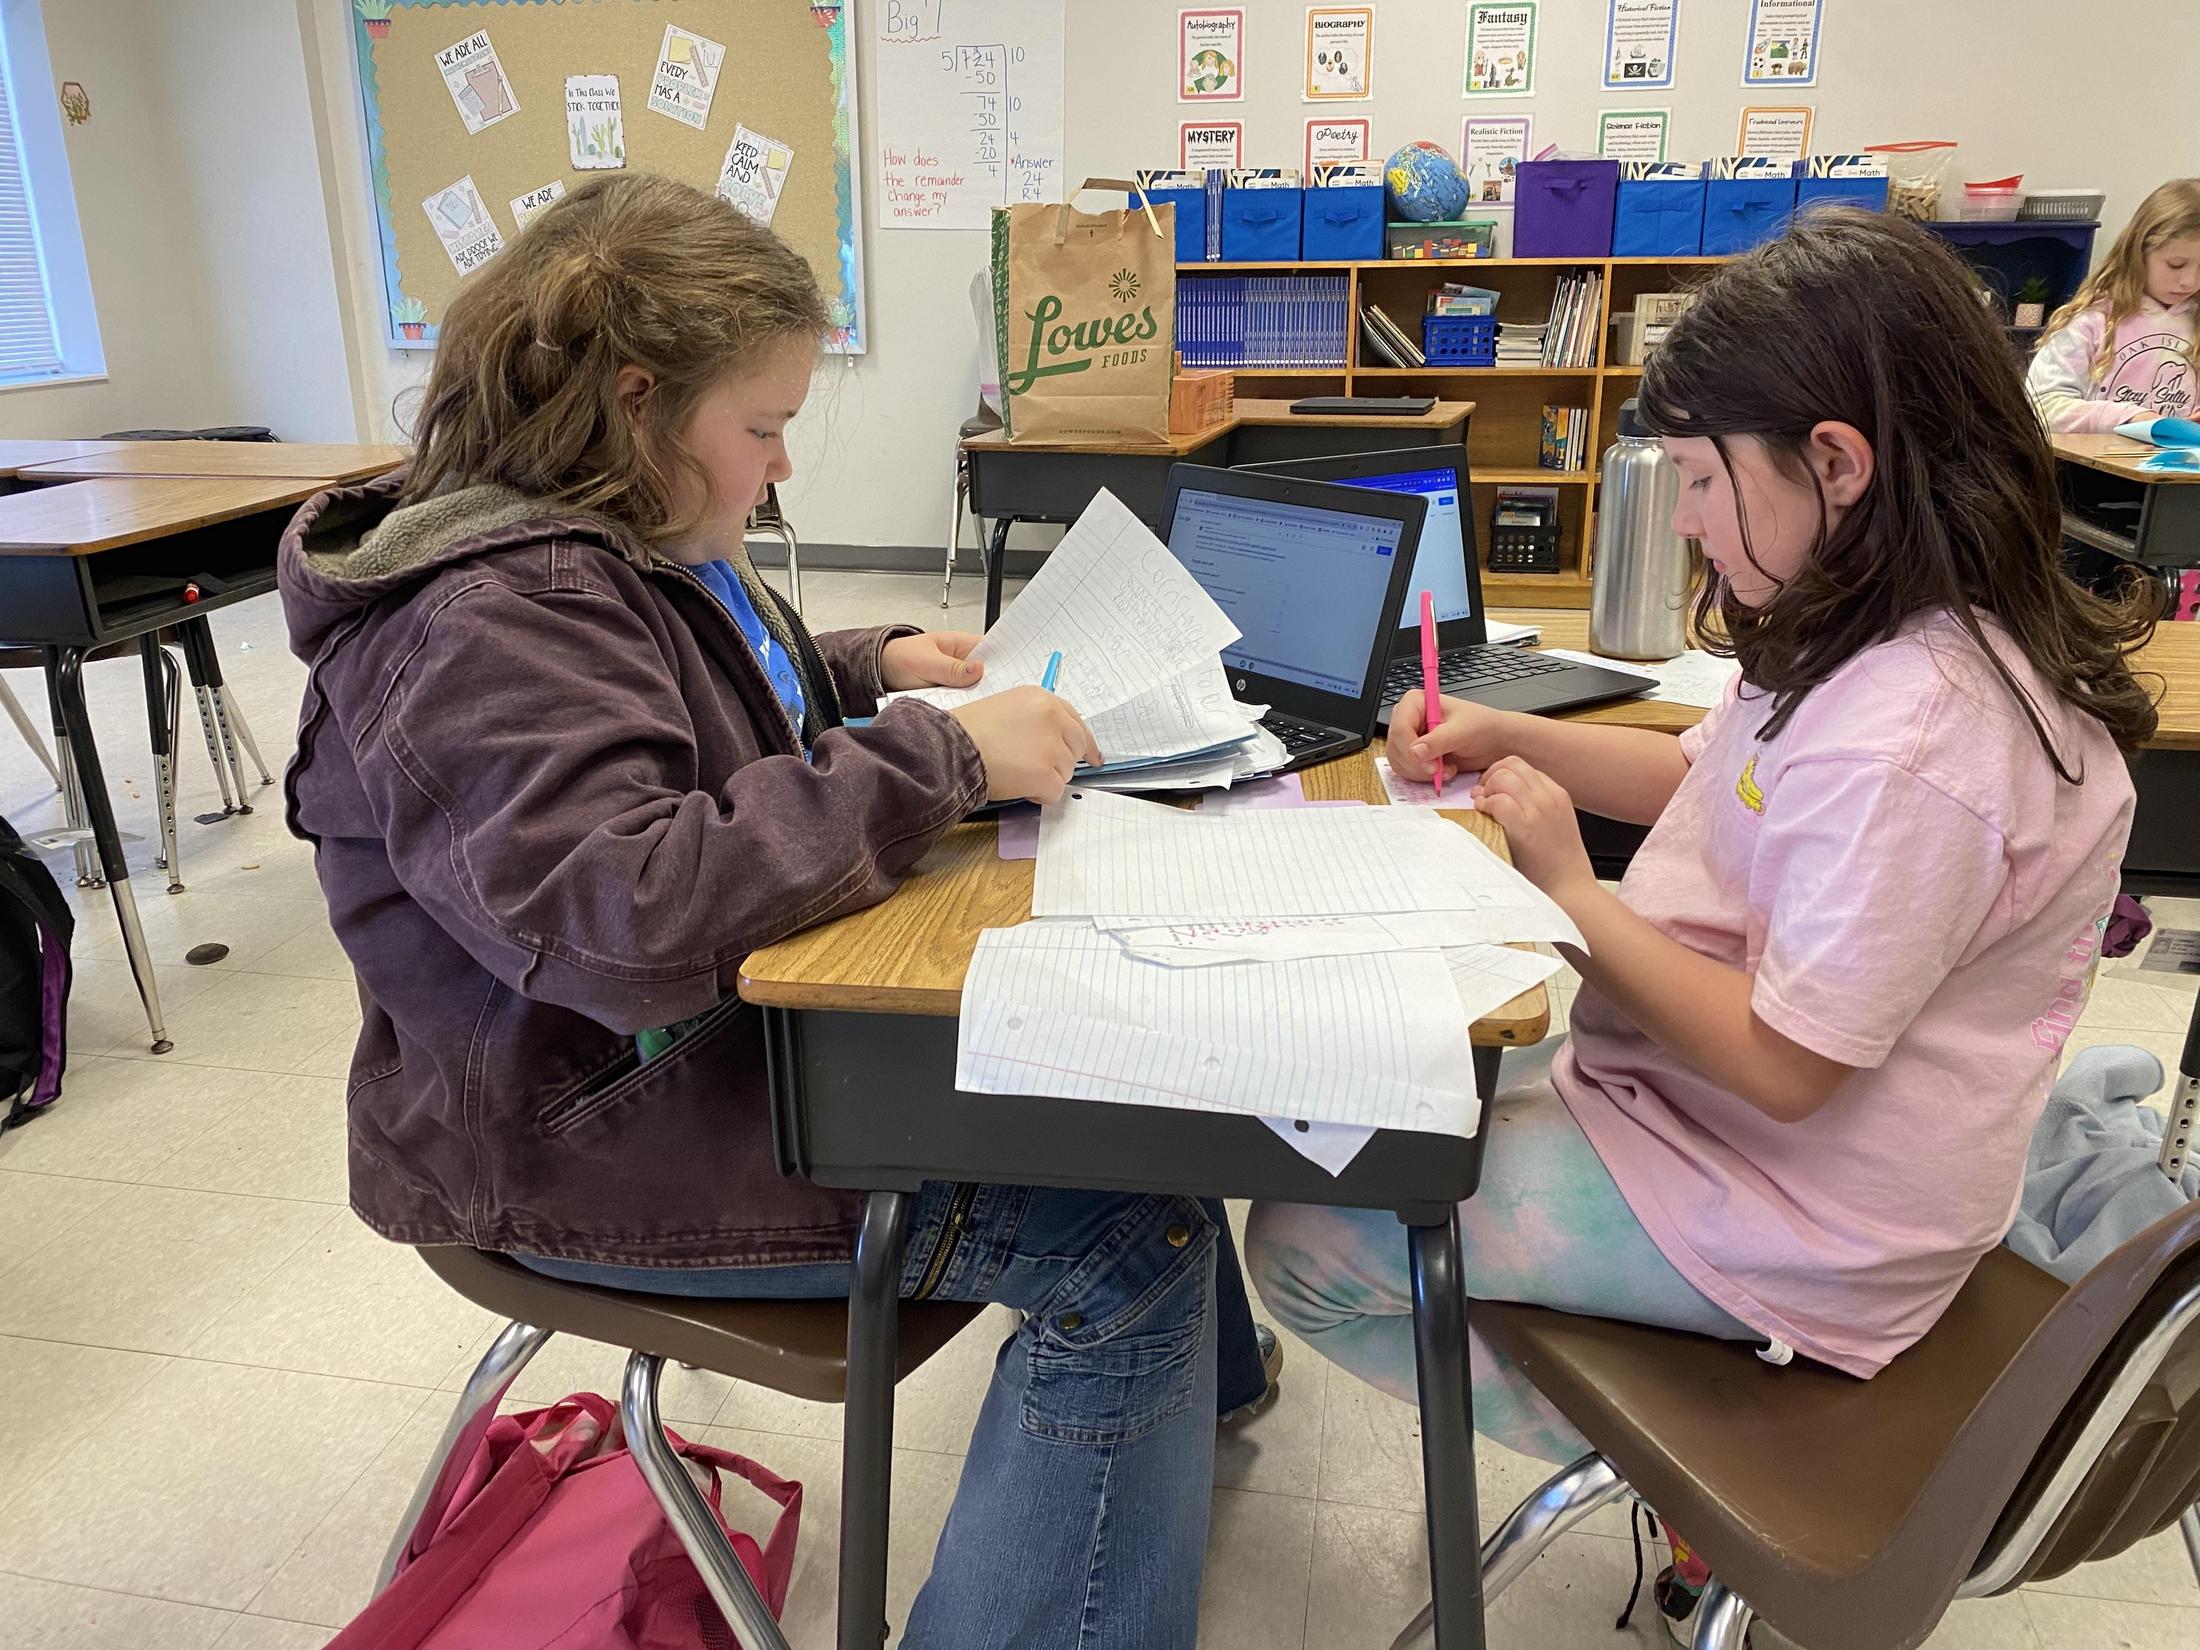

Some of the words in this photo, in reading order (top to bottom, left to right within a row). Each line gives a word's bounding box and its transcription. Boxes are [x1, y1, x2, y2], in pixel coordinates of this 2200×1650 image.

[887, 0, 919, 38] Big
[1187, 17, 1236, 33] Autobiography
[1477, 11, 1528, 25] Fantasy
[440, 51, 454, 66] WE
[455, 42, 471, 61] ARE
[472, 34, 488, 51] ALL
[1010, 47, 1025, 65] 10
[941, 51, 954, 71] 5
[660, 61, 688, 80] EVERY
[589, 87, 603, 96] Class
[673, 92, 680, 103] A
[977, 96, 997, 111] 74
[1009, 96, 1022, 112] 10
[980, 131, 996, 146] 24
[1010, 131, 1019, 145] 4
[1188, 130, 1235, 144] MYSTERY
[1316, 128, 1358, 144] Poetry
[735, 140, 758, 158] KEEP
[731, 153, 759, 174] CALM
[884, 149, 906, 168] How
[913, 148, 939, 166] does
[726, 165, 751, 183] AND
[882, 171, 904, 187] the
[915, 172, 965, 187] remainder
[988, 165, 997, 177] 4
[1023, 172, 1043, 186] 24
[1764, 171, 1785, 179] Math
[1859, 169, 1881, 177] Math
[522, 195, 535, 210] WE
[538, 188, 554, 205] ARE
[888, 188, 926, 207] change
[932, 191, 947, 205] my
[893, 202, 941, 217] answer?
[467, 240, 488, 257] PROOF
[1008, 295, 1157, 395] Lowes
[2119, 340, 2150, 361] OAK
[2161, 337, 2181, 349] ISL
[1101, 349, 1148, 368] FOODS
[2113, 385, 2148, 406] Stay
[2154, 386, 2191, 409] Salty
